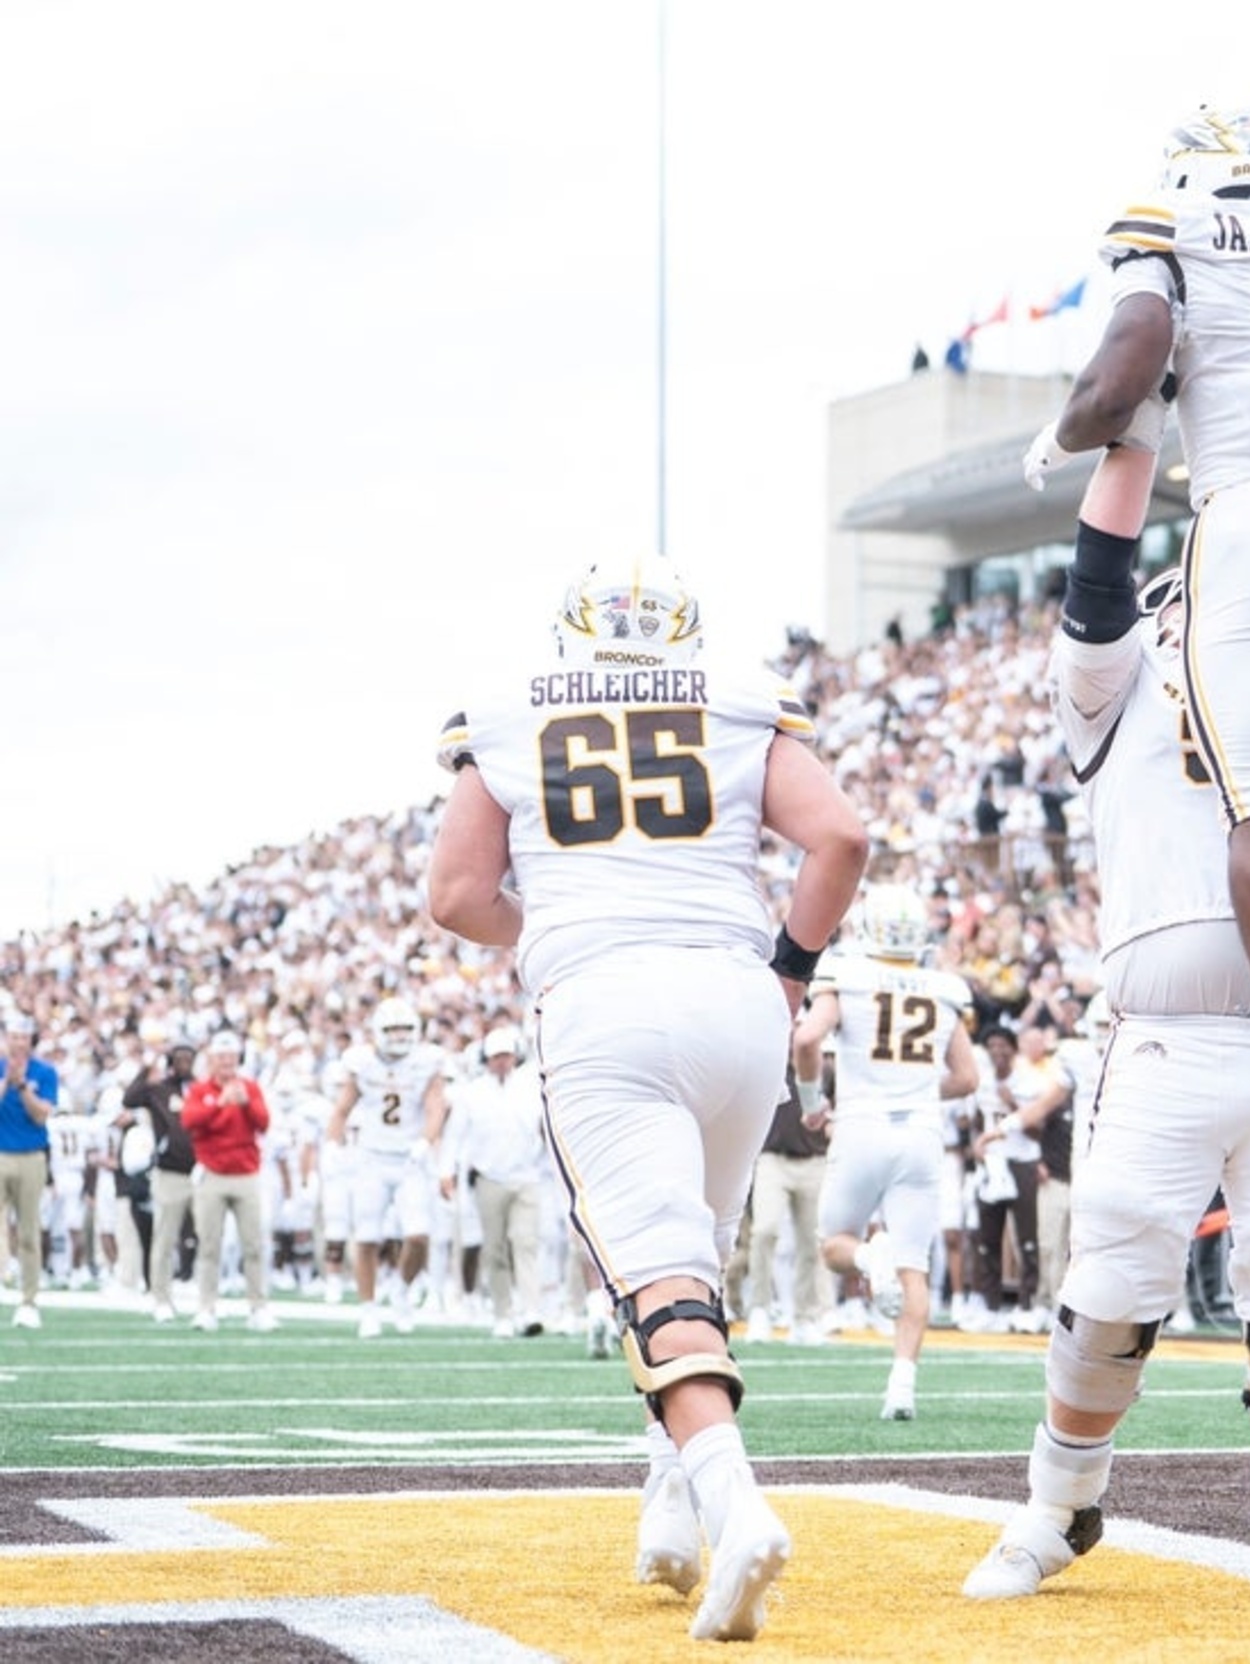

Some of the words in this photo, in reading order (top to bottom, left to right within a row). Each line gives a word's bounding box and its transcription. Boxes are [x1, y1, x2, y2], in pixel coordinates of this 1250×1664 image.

[530, 670, 708, 707] SCHLEICHER
[538, 708, 714, 849] 65
[871, 992, 938, 1065] 12
[381, 1093, 402, 1125] 2
